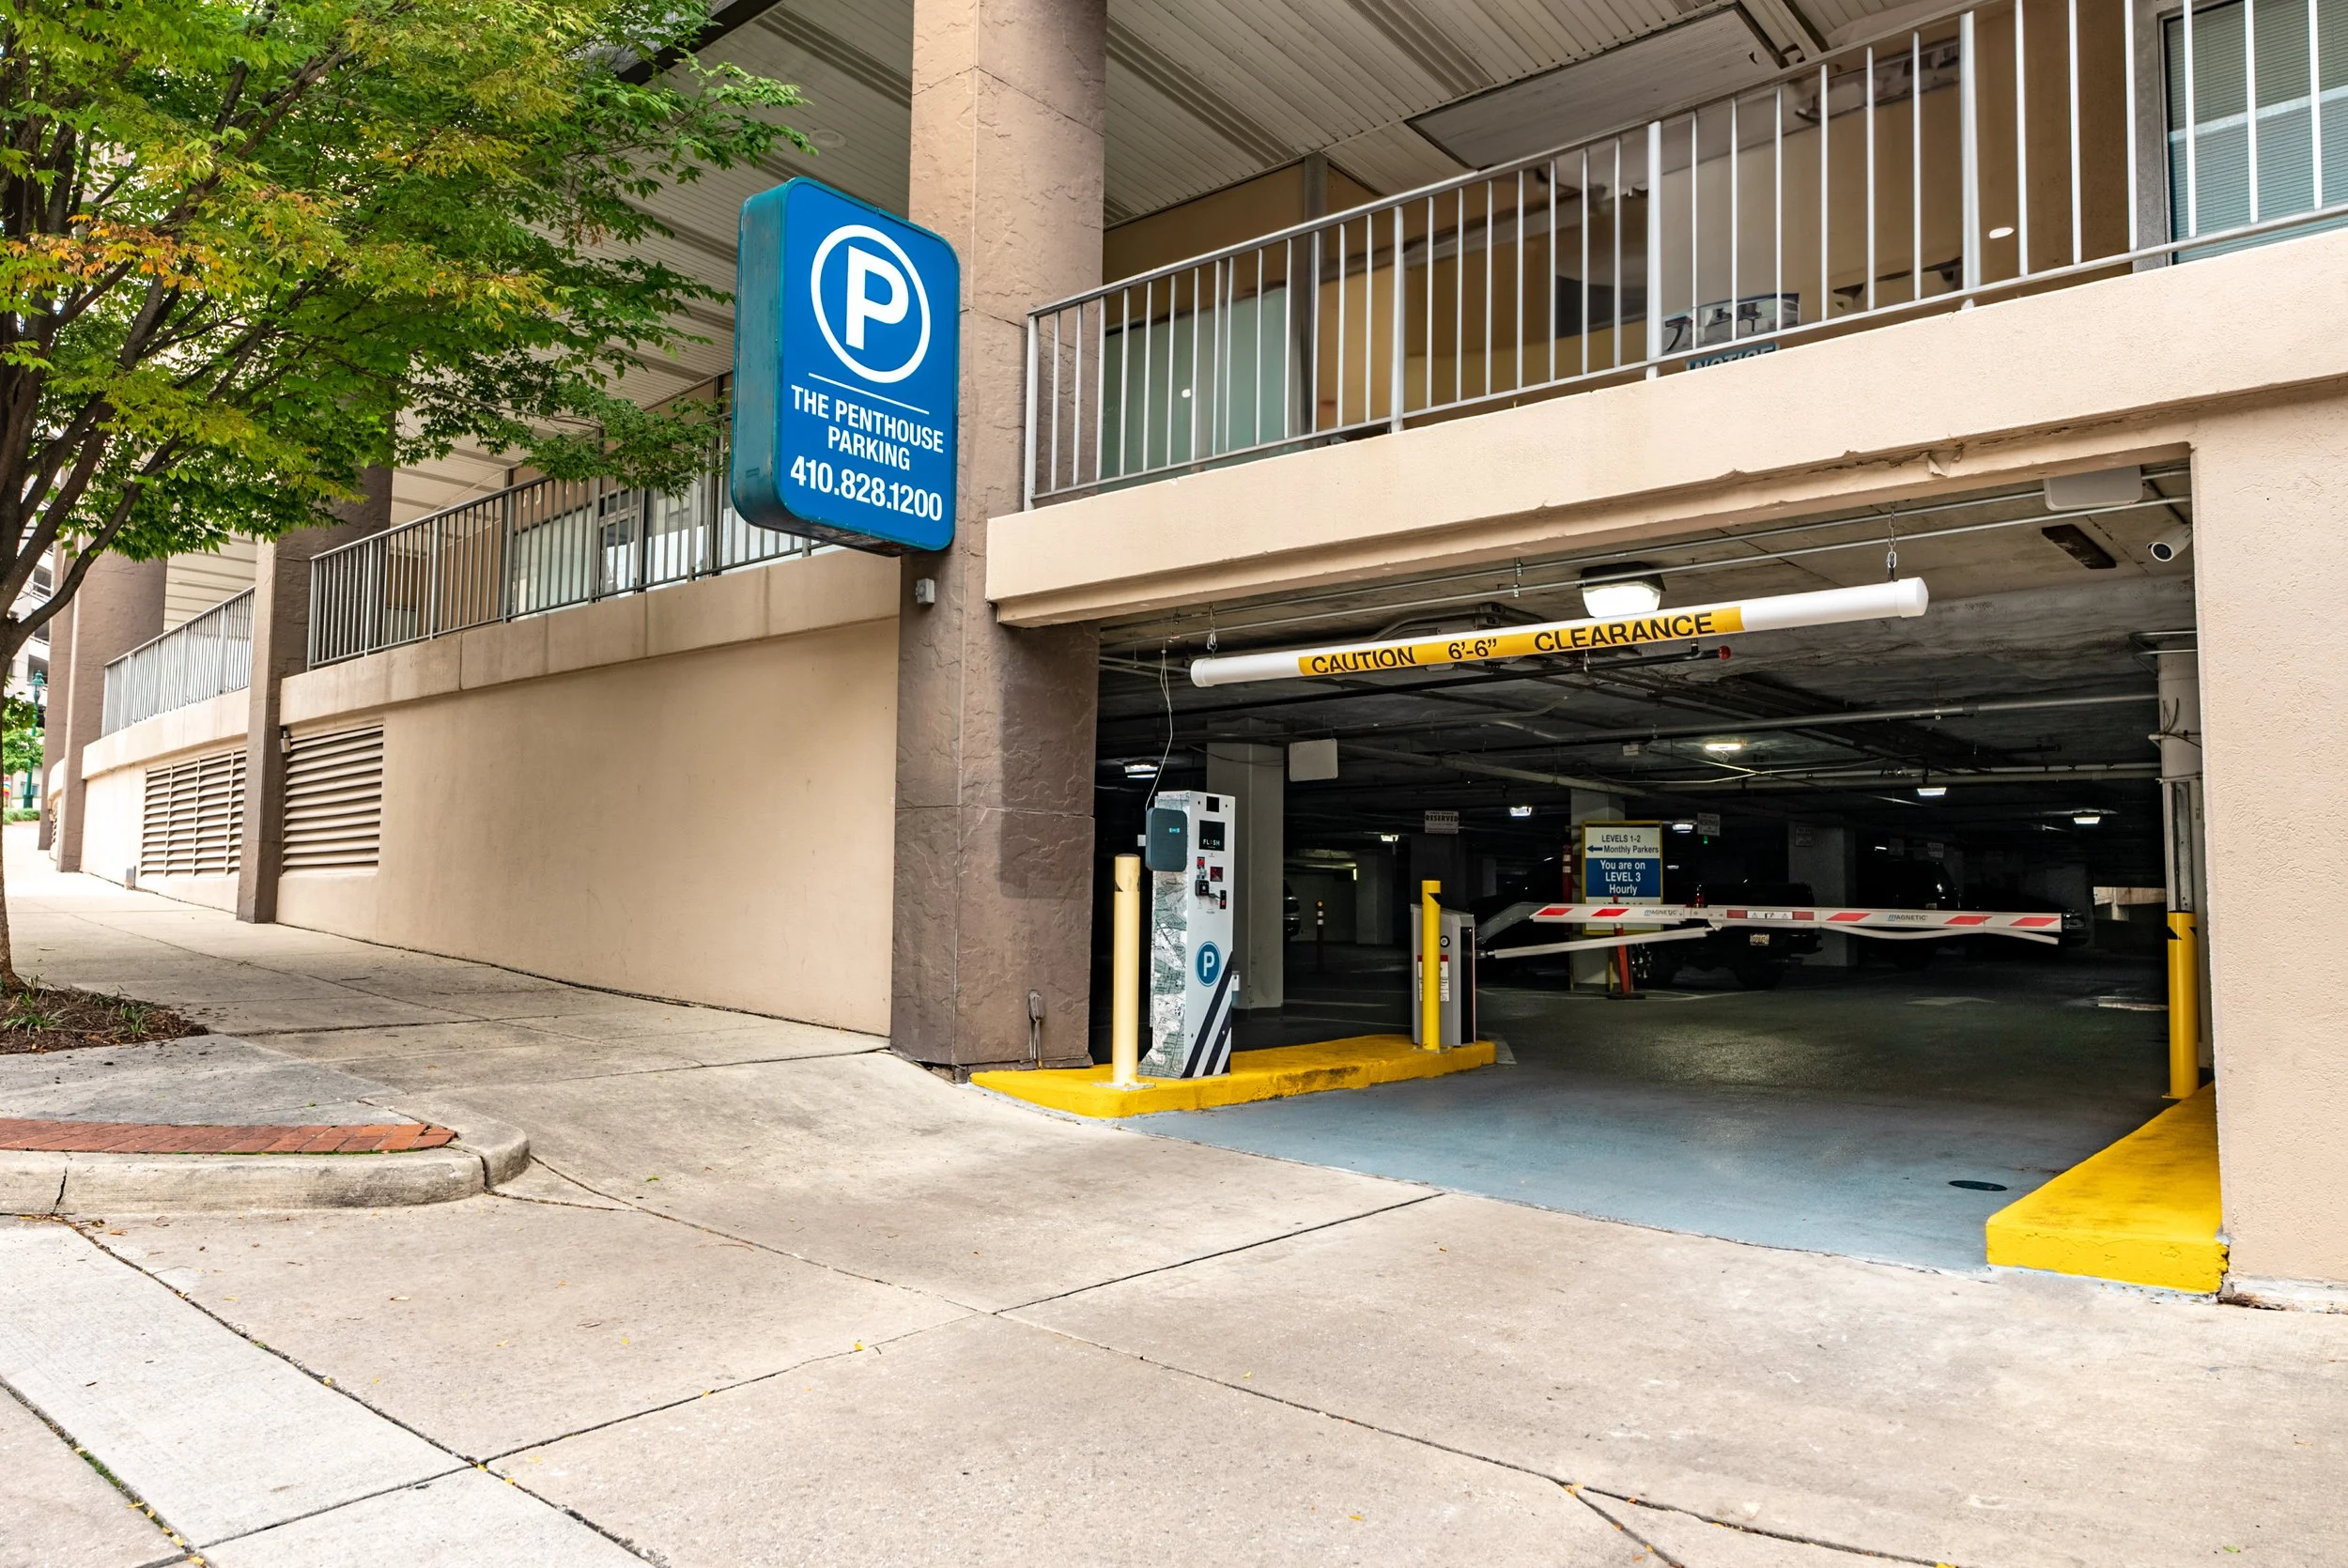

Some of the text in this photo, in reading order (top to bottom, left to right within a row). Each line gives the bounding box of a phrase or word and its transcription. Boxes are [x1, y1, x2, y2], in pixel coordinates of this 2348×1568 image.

[846, 245, 909, 350] P
[791, 384, 944, 453] THE PENTHOUSE
[827, 424, 910, 471] PARKING
[790, 455, 943, 521] 410.828.1200
[1311, 646, 1416, 674] CAUTION
[1535, 612, 1716, 652] CLEARANCE
[1601, 835, 1642, 843] LEVELS 1-2
[1603, 845, 1660, 854] Monthly Parkers
[1600, 860, 1645, 870] You are on
[1605, 872, 1642, 882] LEVEL 3
[1609, 884, 1637, 896] Hourly
[1203, 951, 1215, 977] P
